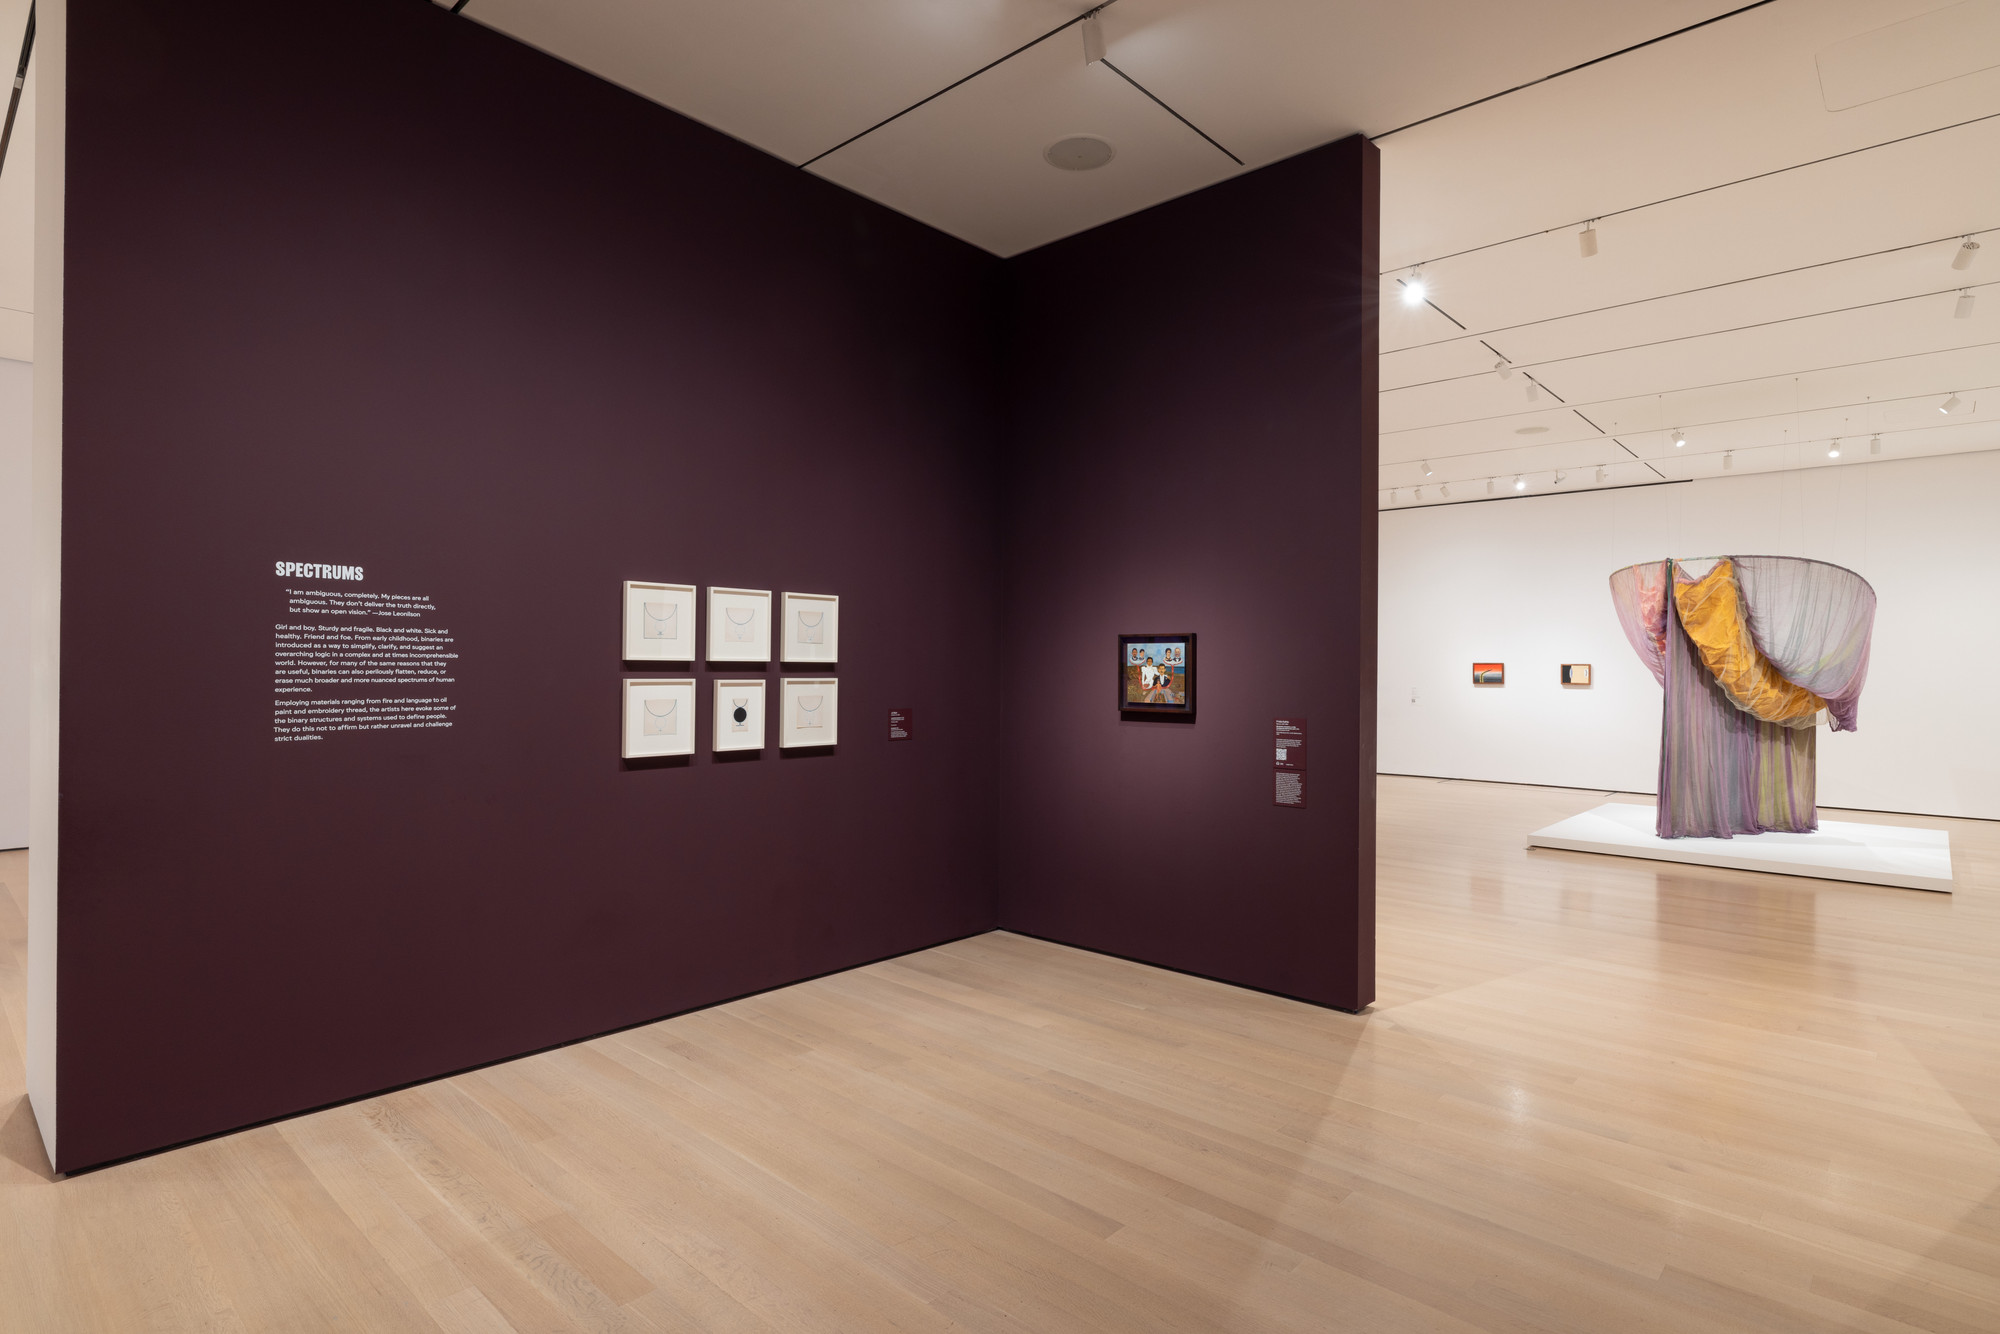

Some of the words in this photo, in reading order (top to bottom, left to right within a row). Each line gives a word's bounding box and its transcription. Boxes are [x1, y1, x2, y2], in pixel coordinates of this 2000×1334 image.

[275, 561, 364, 581] SPECTRUMS
[305, 590, 343, 598] ambiguous,
[344, 592, 380, 600] completely.
[289, 598, 328, 606] ambiguous.
[329, 599, 345, 607] They
[412, 603, 436, 611] directly,
[303, 624, 317, 632] boy.
[318, 624, 339, 632] Sturdy
[353, 625, 375, 633] fragile.
[275, 632, 302, 641] healthy.
[274, 699, 310, 707] Employing
[274, 708, 292, 716] paint
[273, 726, 290, 734] They
